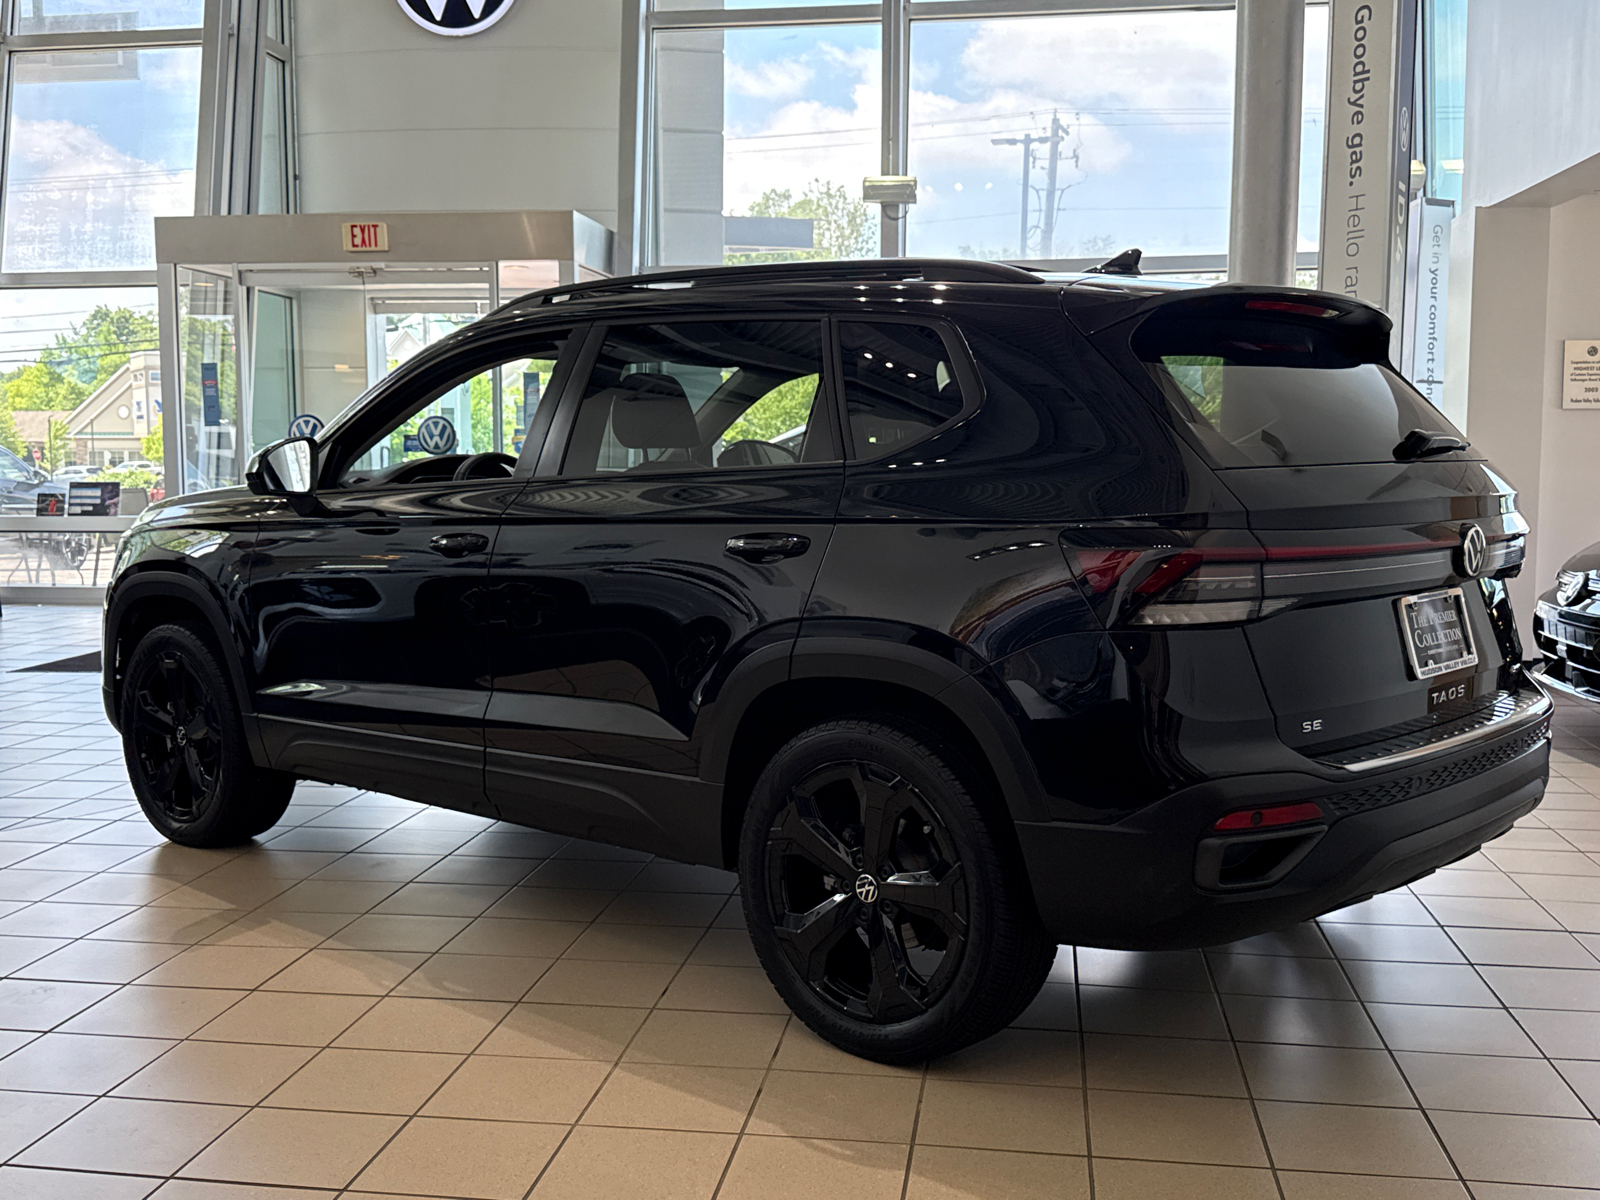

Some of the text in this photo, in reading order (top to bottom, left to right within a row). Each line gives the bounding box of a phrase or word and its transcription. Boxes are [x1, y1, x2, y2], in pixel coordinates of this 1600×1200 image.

[1347, 4, 1372, 125] Goodbye
[1345, 132, 1364, 187] gas.
[350, 224, 379, 248] EXIT
[1346, 193, 1366, 257] Hello
[1432, 224, 1443, 248] Get
[1431, 252, 1442, 264] in
[1429, 267, 1439, 302] your
[1426, 304, 1438, 364] comfort
[1414, 627, 1462, 648] COLLECTION
[1420, 665, 1443, 677] HUDSON
[1443, 661, 1460, 672] VALLEY
[1431, 684, 1466, 705] TAOS
[1301, 719, 1323, 733] SE
